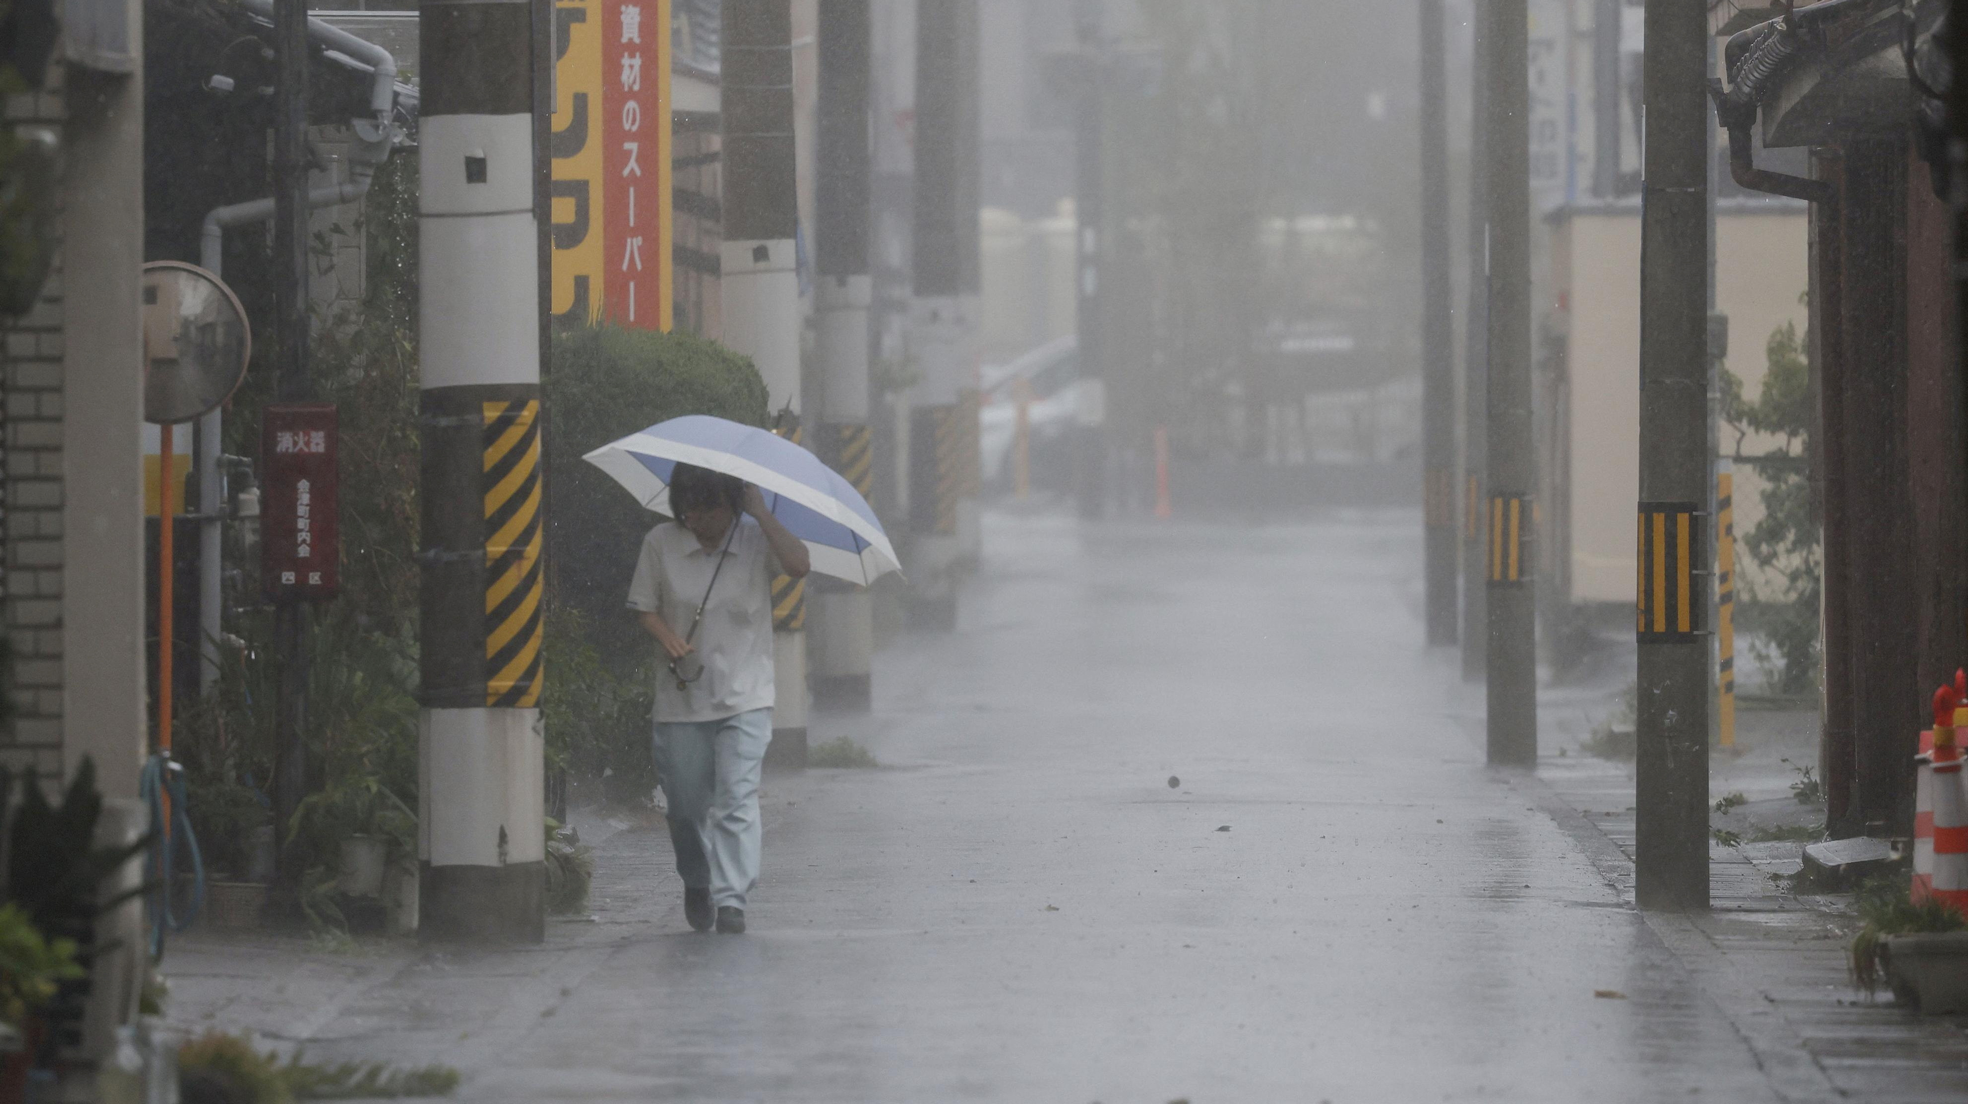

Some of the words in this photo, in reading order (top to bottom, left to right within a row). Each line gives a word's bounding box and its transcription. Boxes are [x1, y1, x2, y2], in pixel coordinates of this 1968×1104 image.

[620, 4, 643, 322] 資材のスーパー
[276, 431, 325, 453] 消火器
